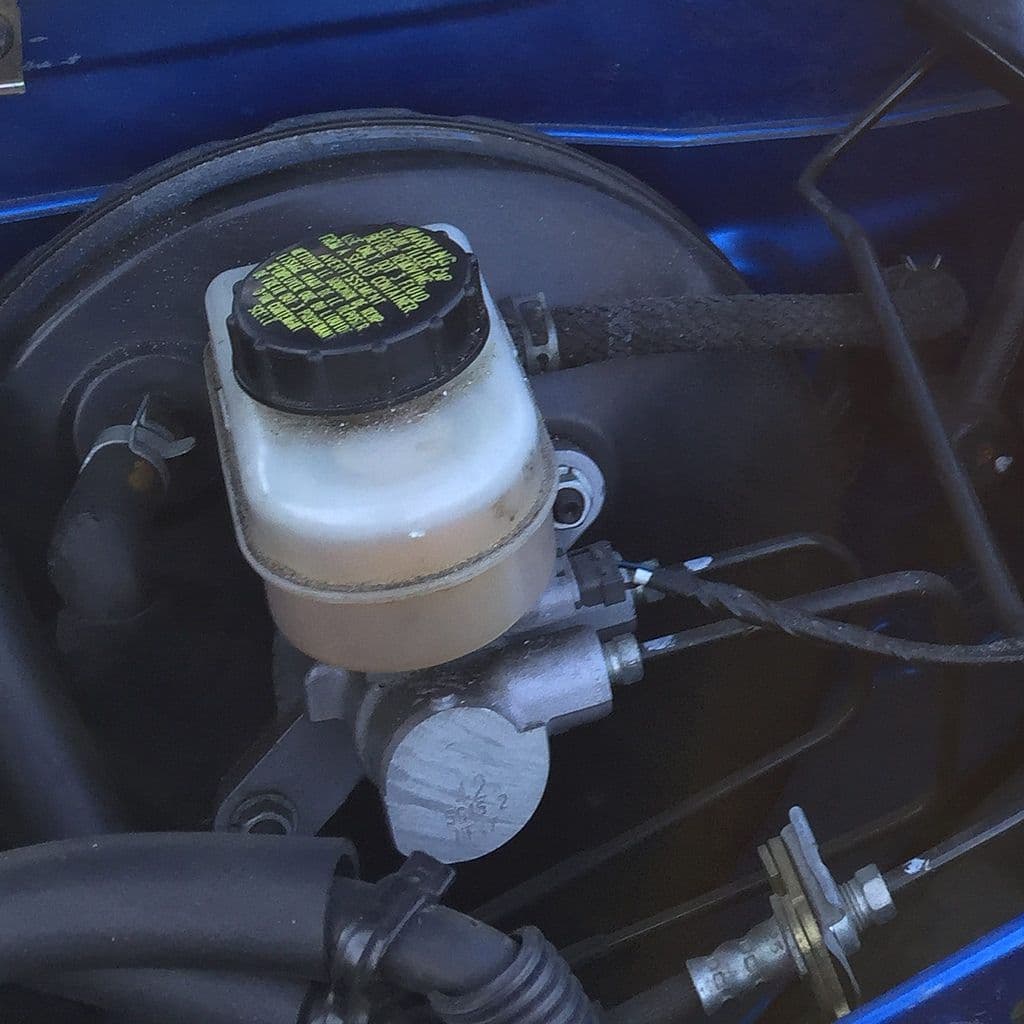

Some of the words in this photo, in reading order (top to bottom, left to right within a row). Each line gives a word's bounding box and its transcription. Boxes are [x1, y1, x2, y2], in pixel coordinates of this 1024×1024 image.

[318, 233, 345, 250] FROM
[336, 248, 351, 256] A
[363, 233, 398, 255] BEFORE
[343, 253, 378, 276] SEALED
[379, 228, 410, 247] CLEAN
[401, 244, 437, 269] FILLER
[429, 268, 452, 281] CAP
[290, 247, 325, 270] NETTOYER
[316, 268, 333, 278] LE
[325, 276, 358, 301] BOUCHON
[350, 298, 368, 308] DE
[318, 253, 386, 305] AVERTISSEMENT
[340, 233, 364, 246] USE
[355, 244, 382, 260] ONLY
[373, 259, 398, 273] DOT
[389, 272, 406, 280] 3
[398, 278, 430, 302] FLUID
[278, 292, 299, 305] DOT
[298, 272, 325, 289] AVANT
[316, 287, 334, 298] DE
[326, 296, 344, 306] LE
[309, 300, 328, 311] DU
